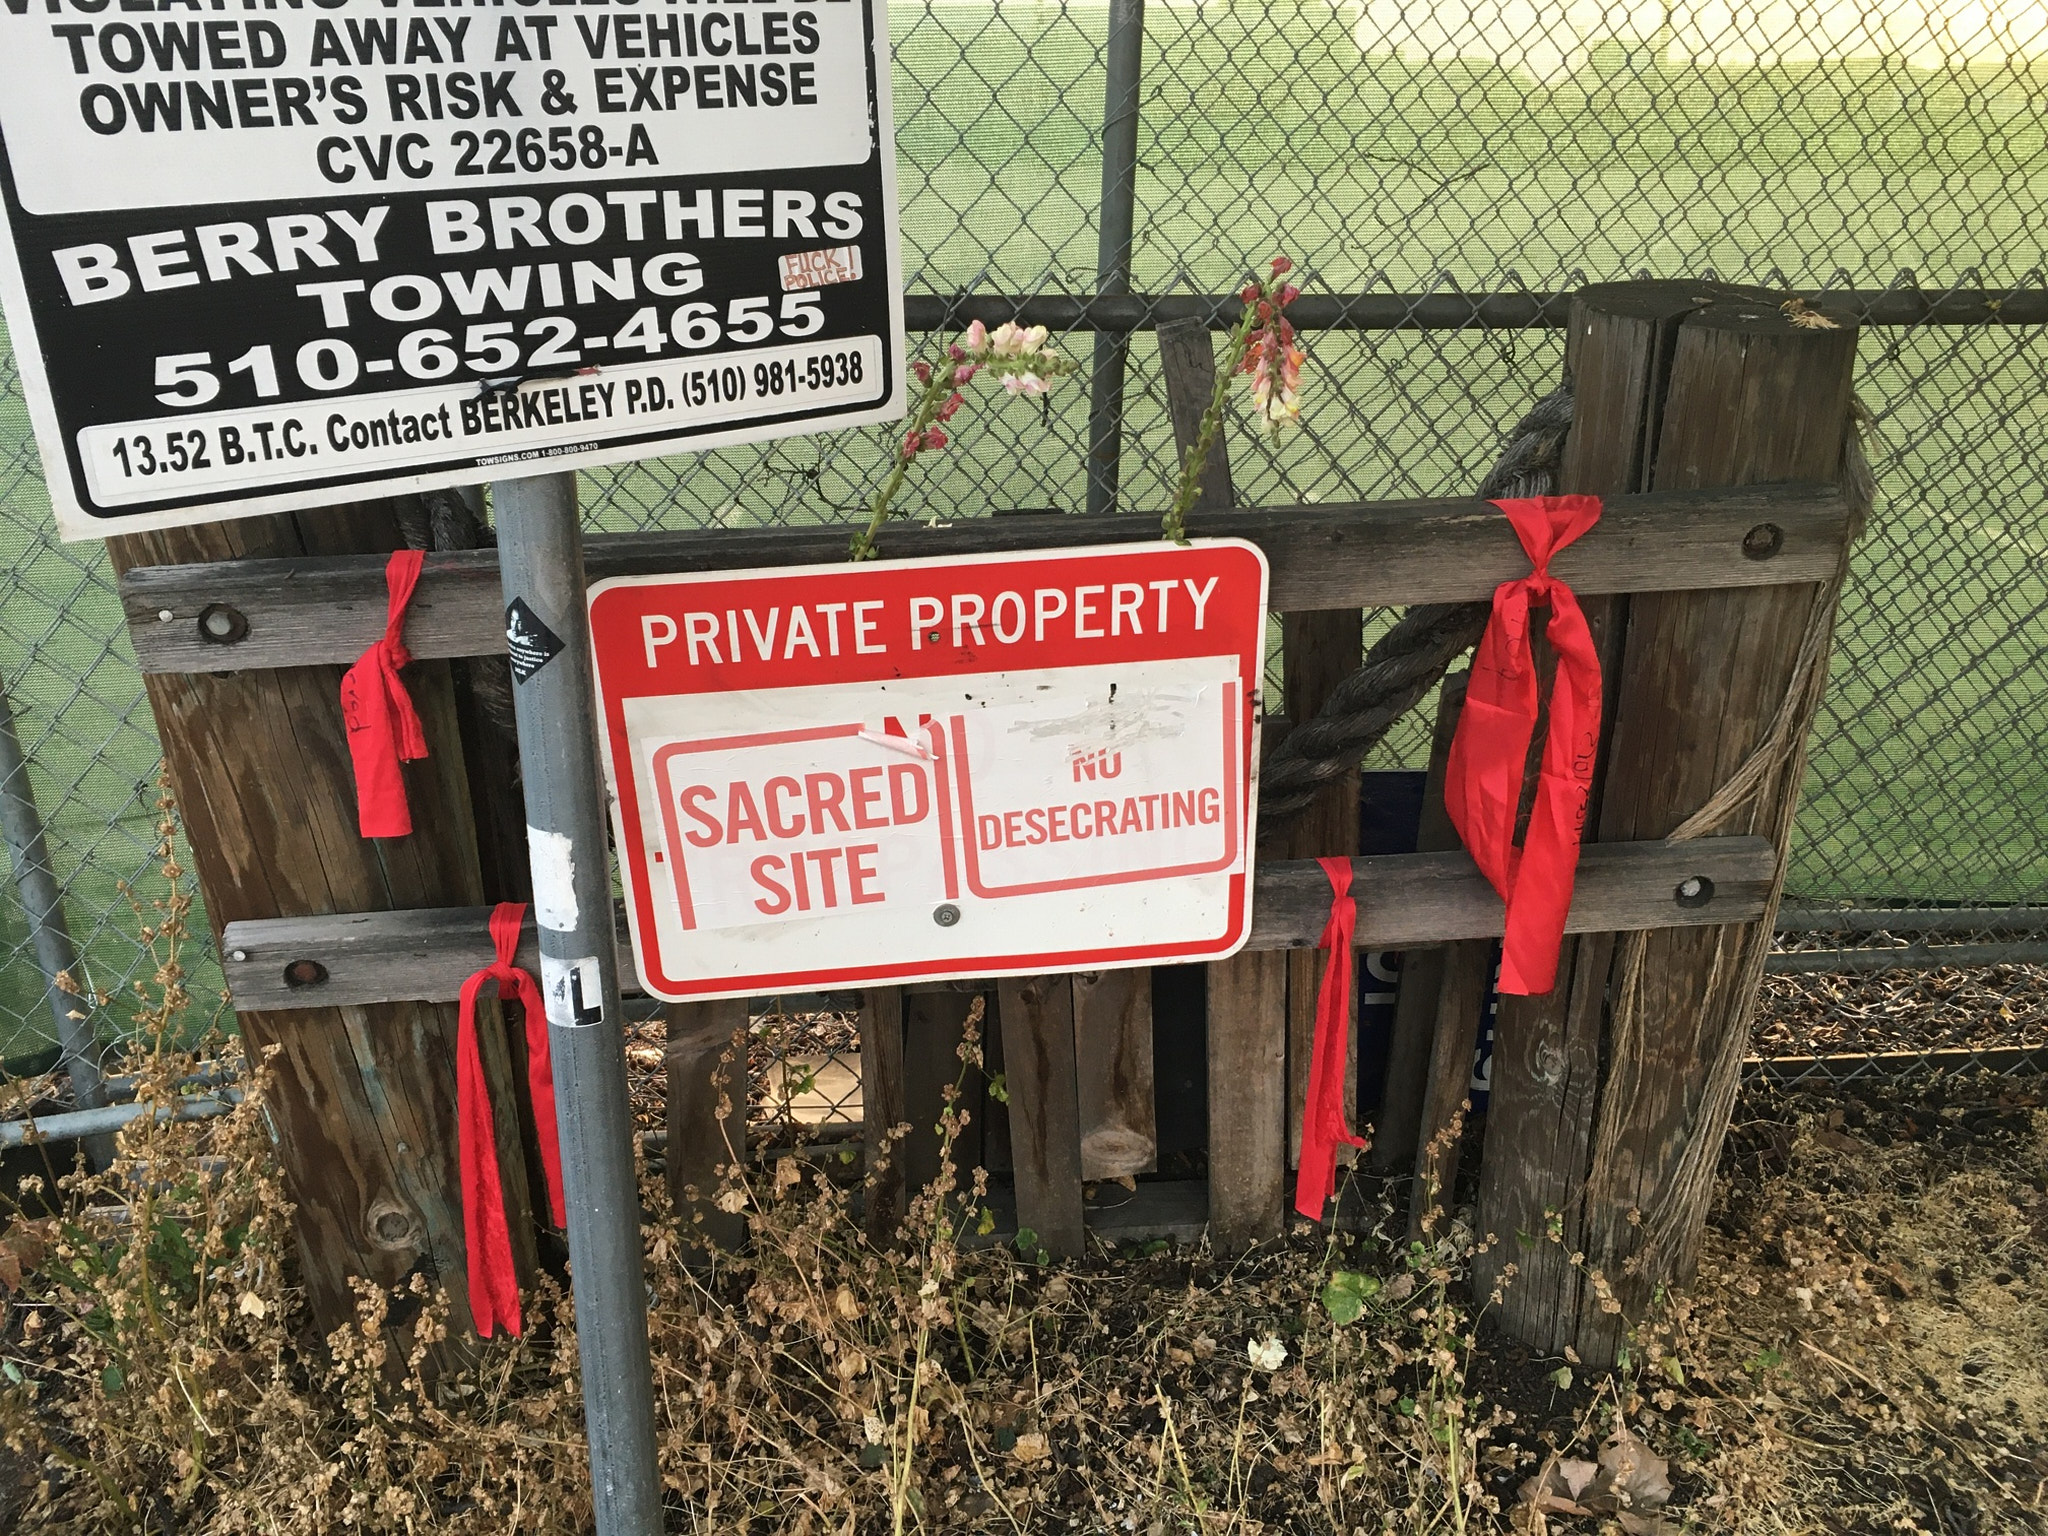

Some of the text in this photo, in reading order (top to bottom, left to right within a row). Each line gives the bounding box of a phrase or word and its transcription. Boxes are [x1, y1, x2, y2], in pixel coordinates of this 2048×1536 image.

[52, 12, 819, 73] TOWED AWAY AT VEHICLES
[81, 63, 817, 135] OWNER'S RISK & EXPENSE
[317, 124, 659, 183] CVC 22658-A
[52, 190, 863, 306] BERRY BROTHERS
[296, 253, 703, 328] TOWING
[155, 291, 824, 406] 510-652-4655
[113, 351, 862, 475] 13.52 B.T.C. Contact BERKELEY P.D. (510) 981-5938
[476, 443, 598, 466] TOWSIGNS.COM 1-800-800-9470
[641, 577, 1219, 668] PRIVATE PROPERTY
[680, 763, 929, 847] SACRED
[979, 788, 1219, 850] DESECRATING
[750, 844, 885, 915] SITE
